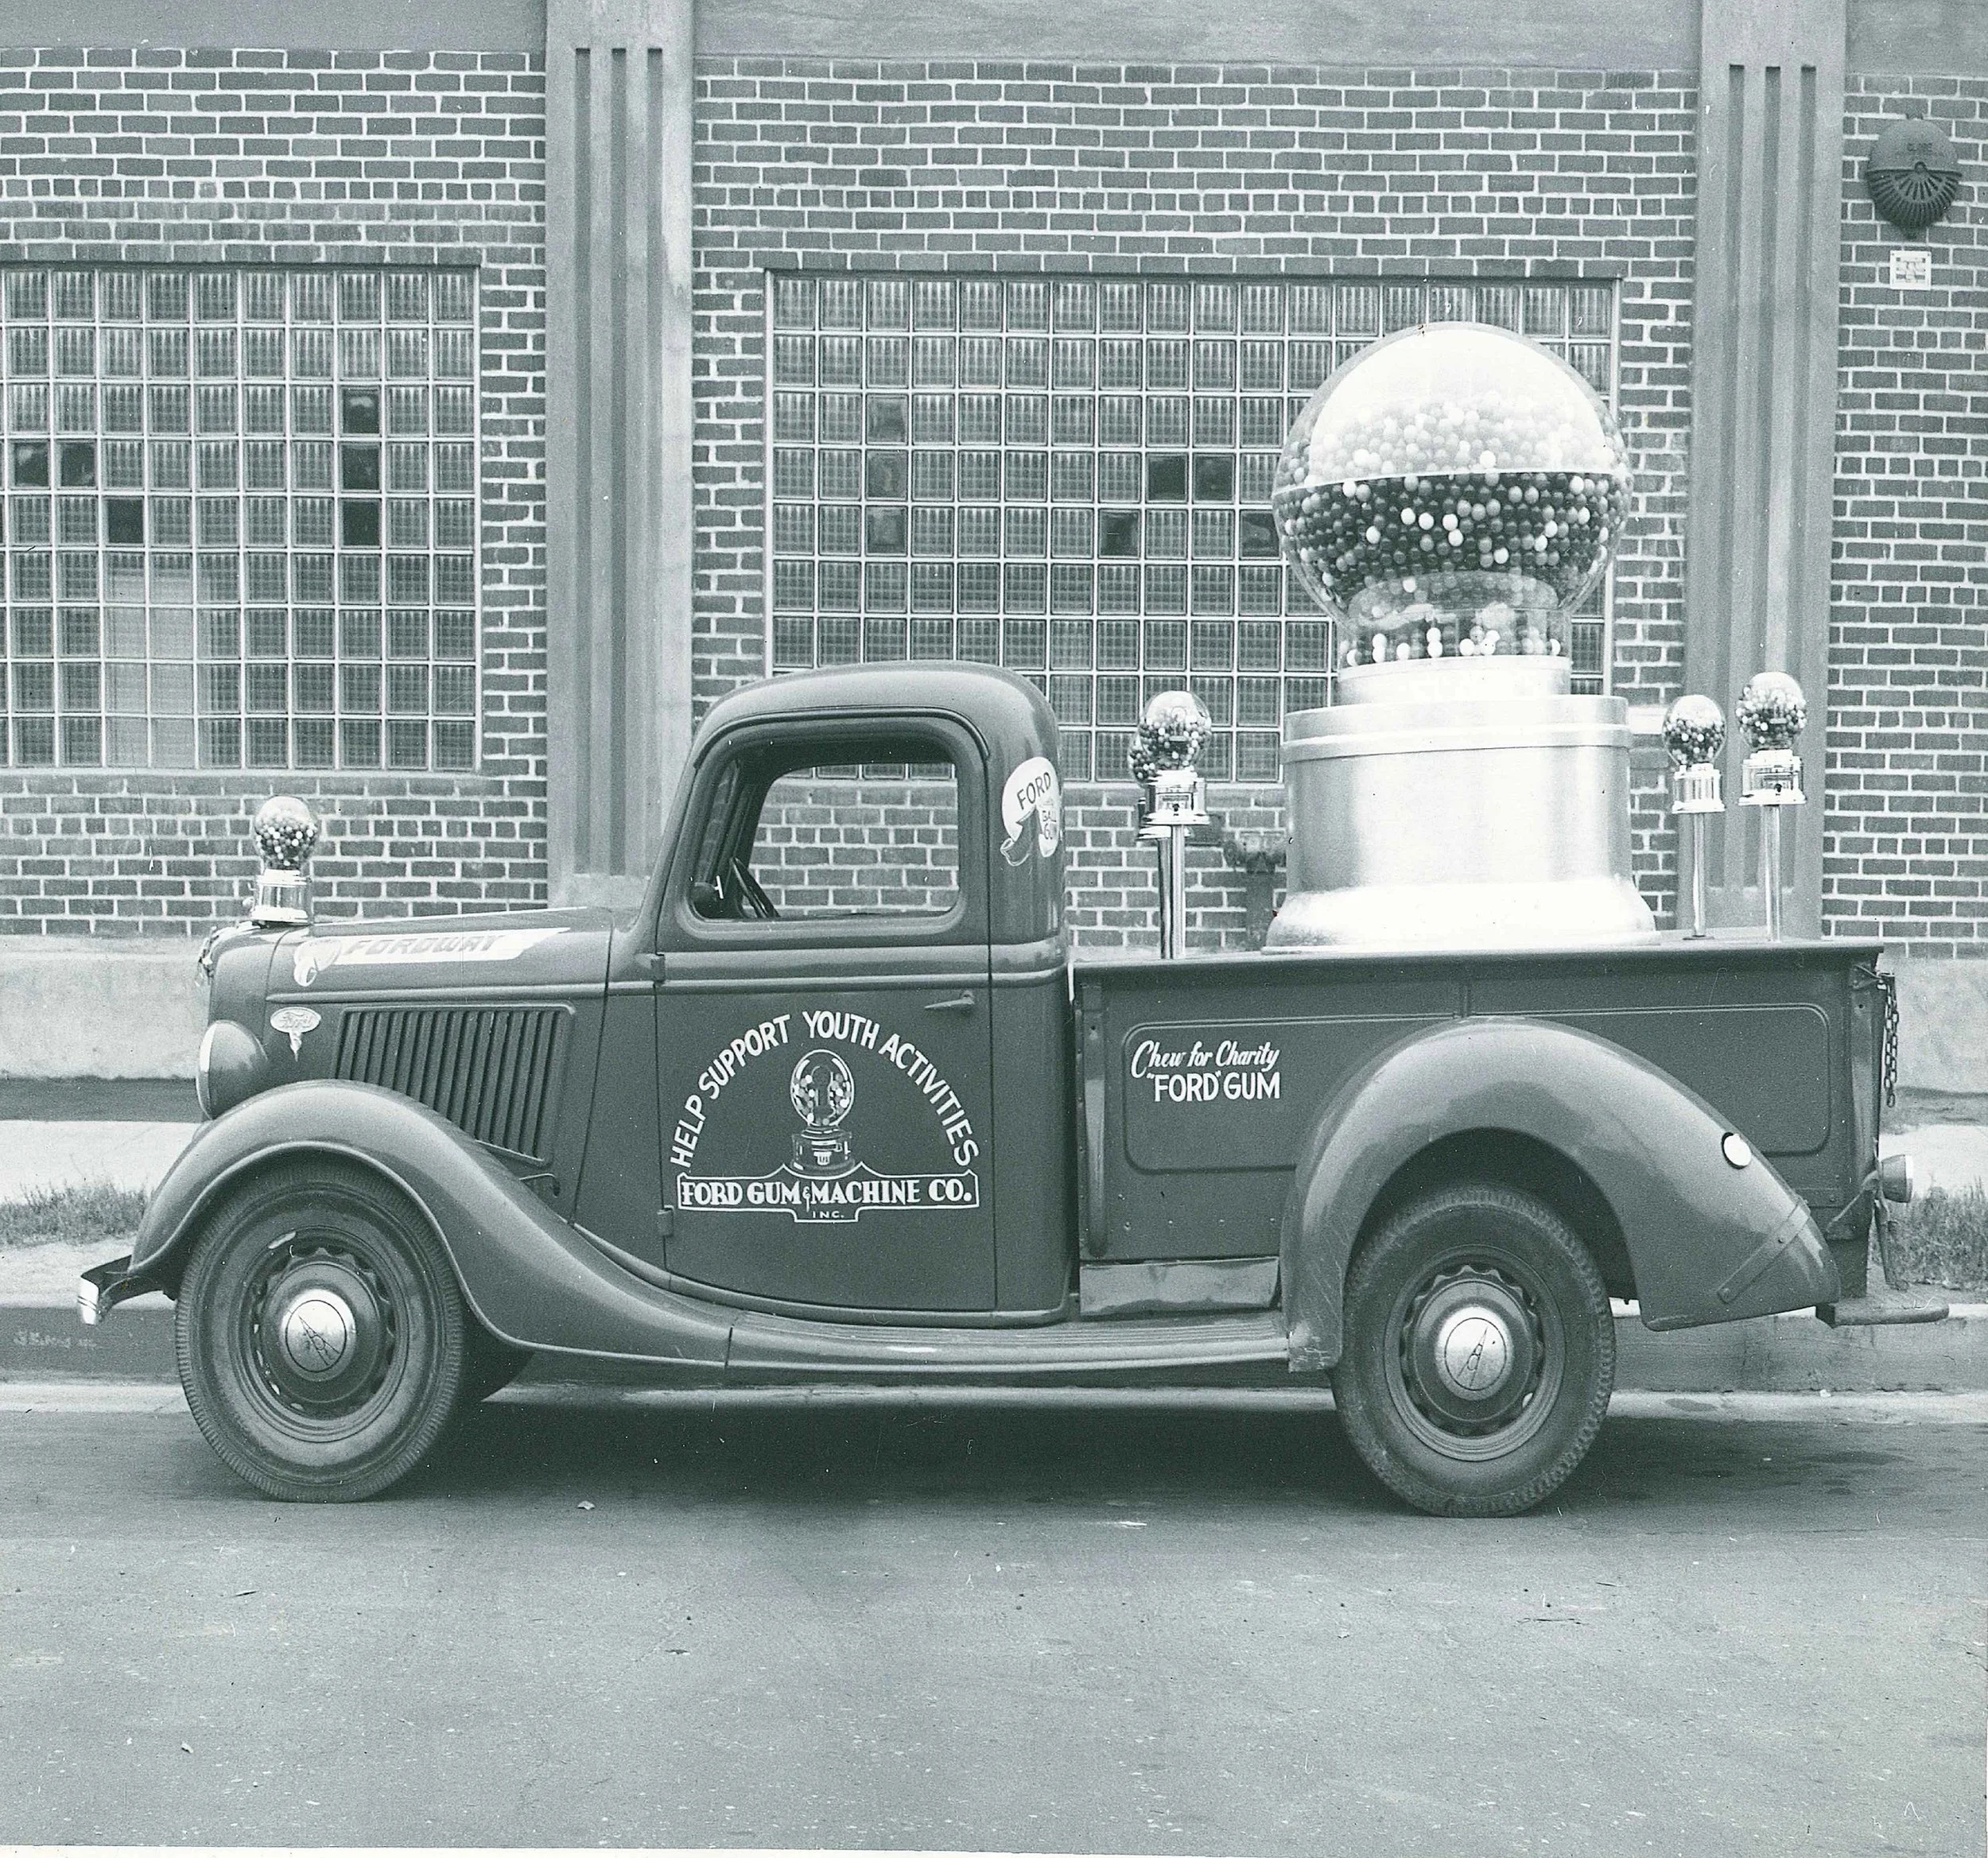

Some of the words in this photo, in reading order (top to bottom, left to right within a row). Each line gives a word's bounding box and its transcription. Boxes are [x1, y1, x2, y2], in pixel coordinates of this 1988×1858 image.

[1017, 772, 1051, 810] FORD
[1131, 1041, 1186, 1078] Chew
[1187, 1041, 1213, 1067] for
[1215, 1040, 1280, 1073] Charity
[670, 1094, 705, 1167] HELP
[699, 1014, 790, 1100] SUPPORT
[802, 1011, 879, 1049] YOUTH
[879, 1034, 979, 1166] ACTIVITIES
[1146, 1070, 1221, 1102] "FORD"
[1223, 1071, 1280, 1100] GUM
[681, 1181, 744, 1205] FORD
[747, 1181, 802, 1204] GUM
[810, 1179, 921, 1204] MACHINE
[928, 1179, 973, 1201] CO.
[812, 1210, 845, 1219] INC.
